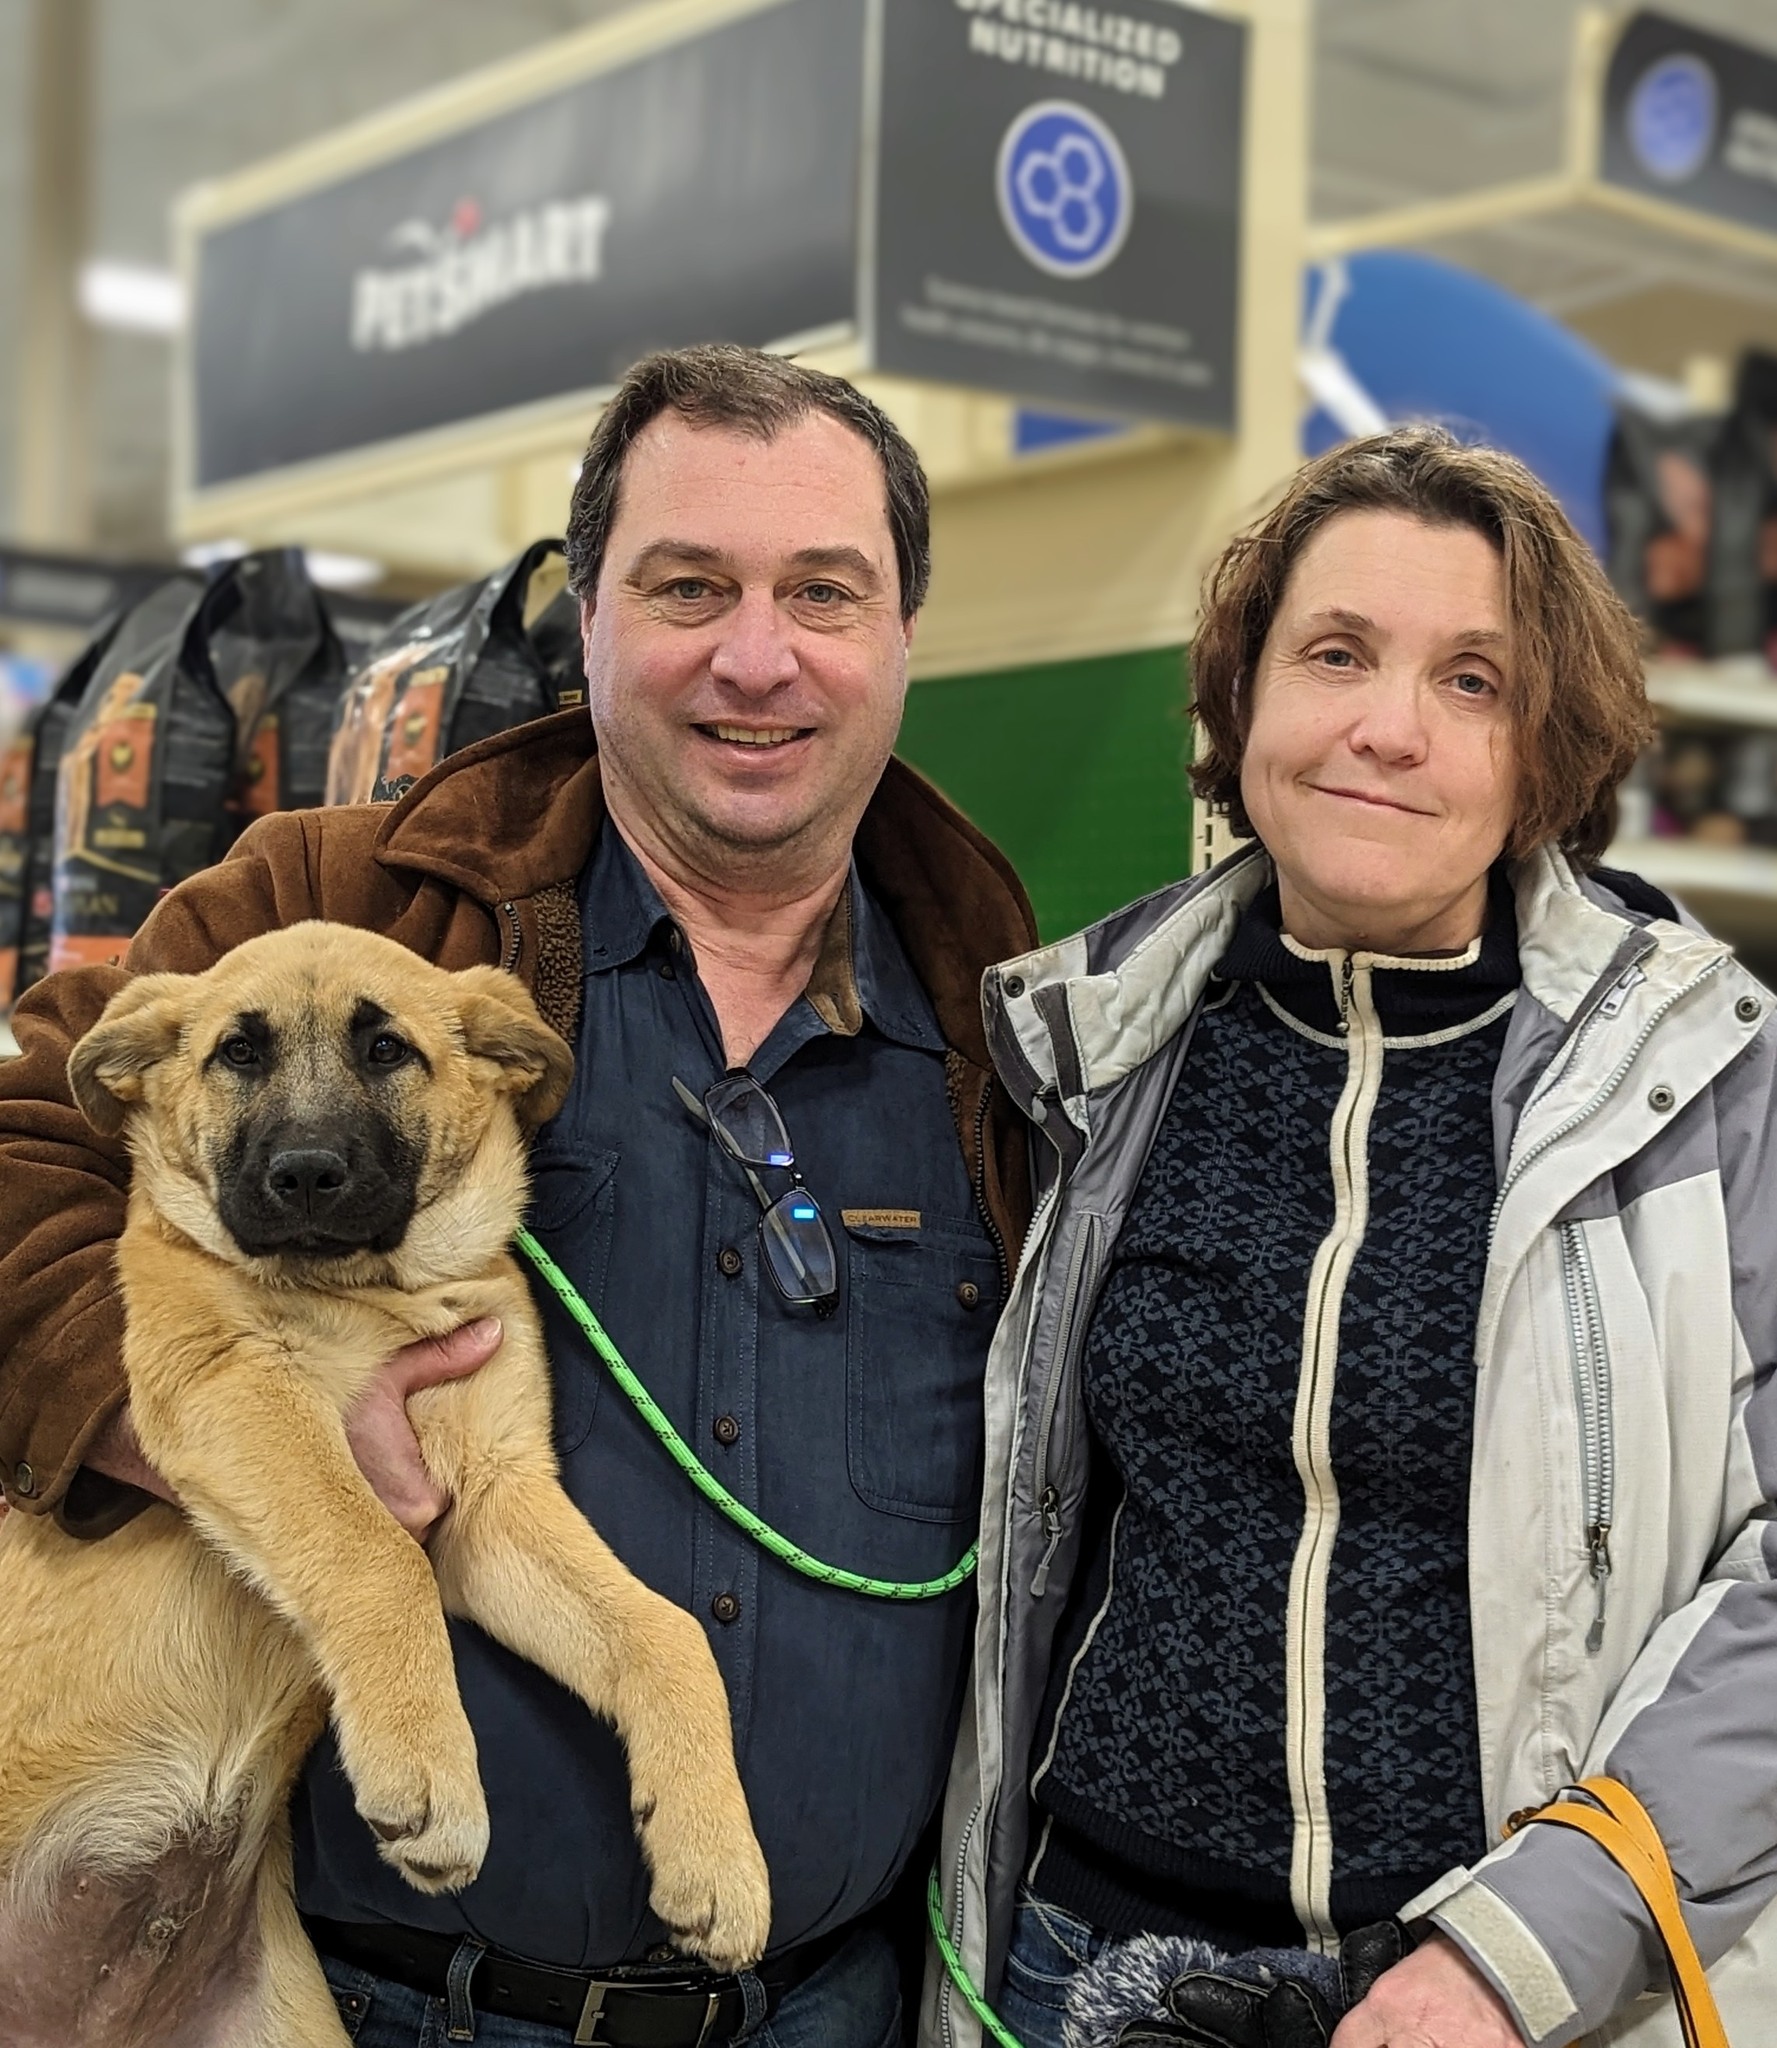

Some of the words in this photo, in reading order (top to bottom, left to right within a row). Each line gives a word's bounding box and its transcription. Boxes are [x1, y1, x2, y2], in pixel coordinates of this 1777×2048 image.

[956, 0, 1181, 65] ECIALIZED
[969, 17, 1165, 98] NUTRITION
[847, 1214, 917, 1223] CLEARWATER
